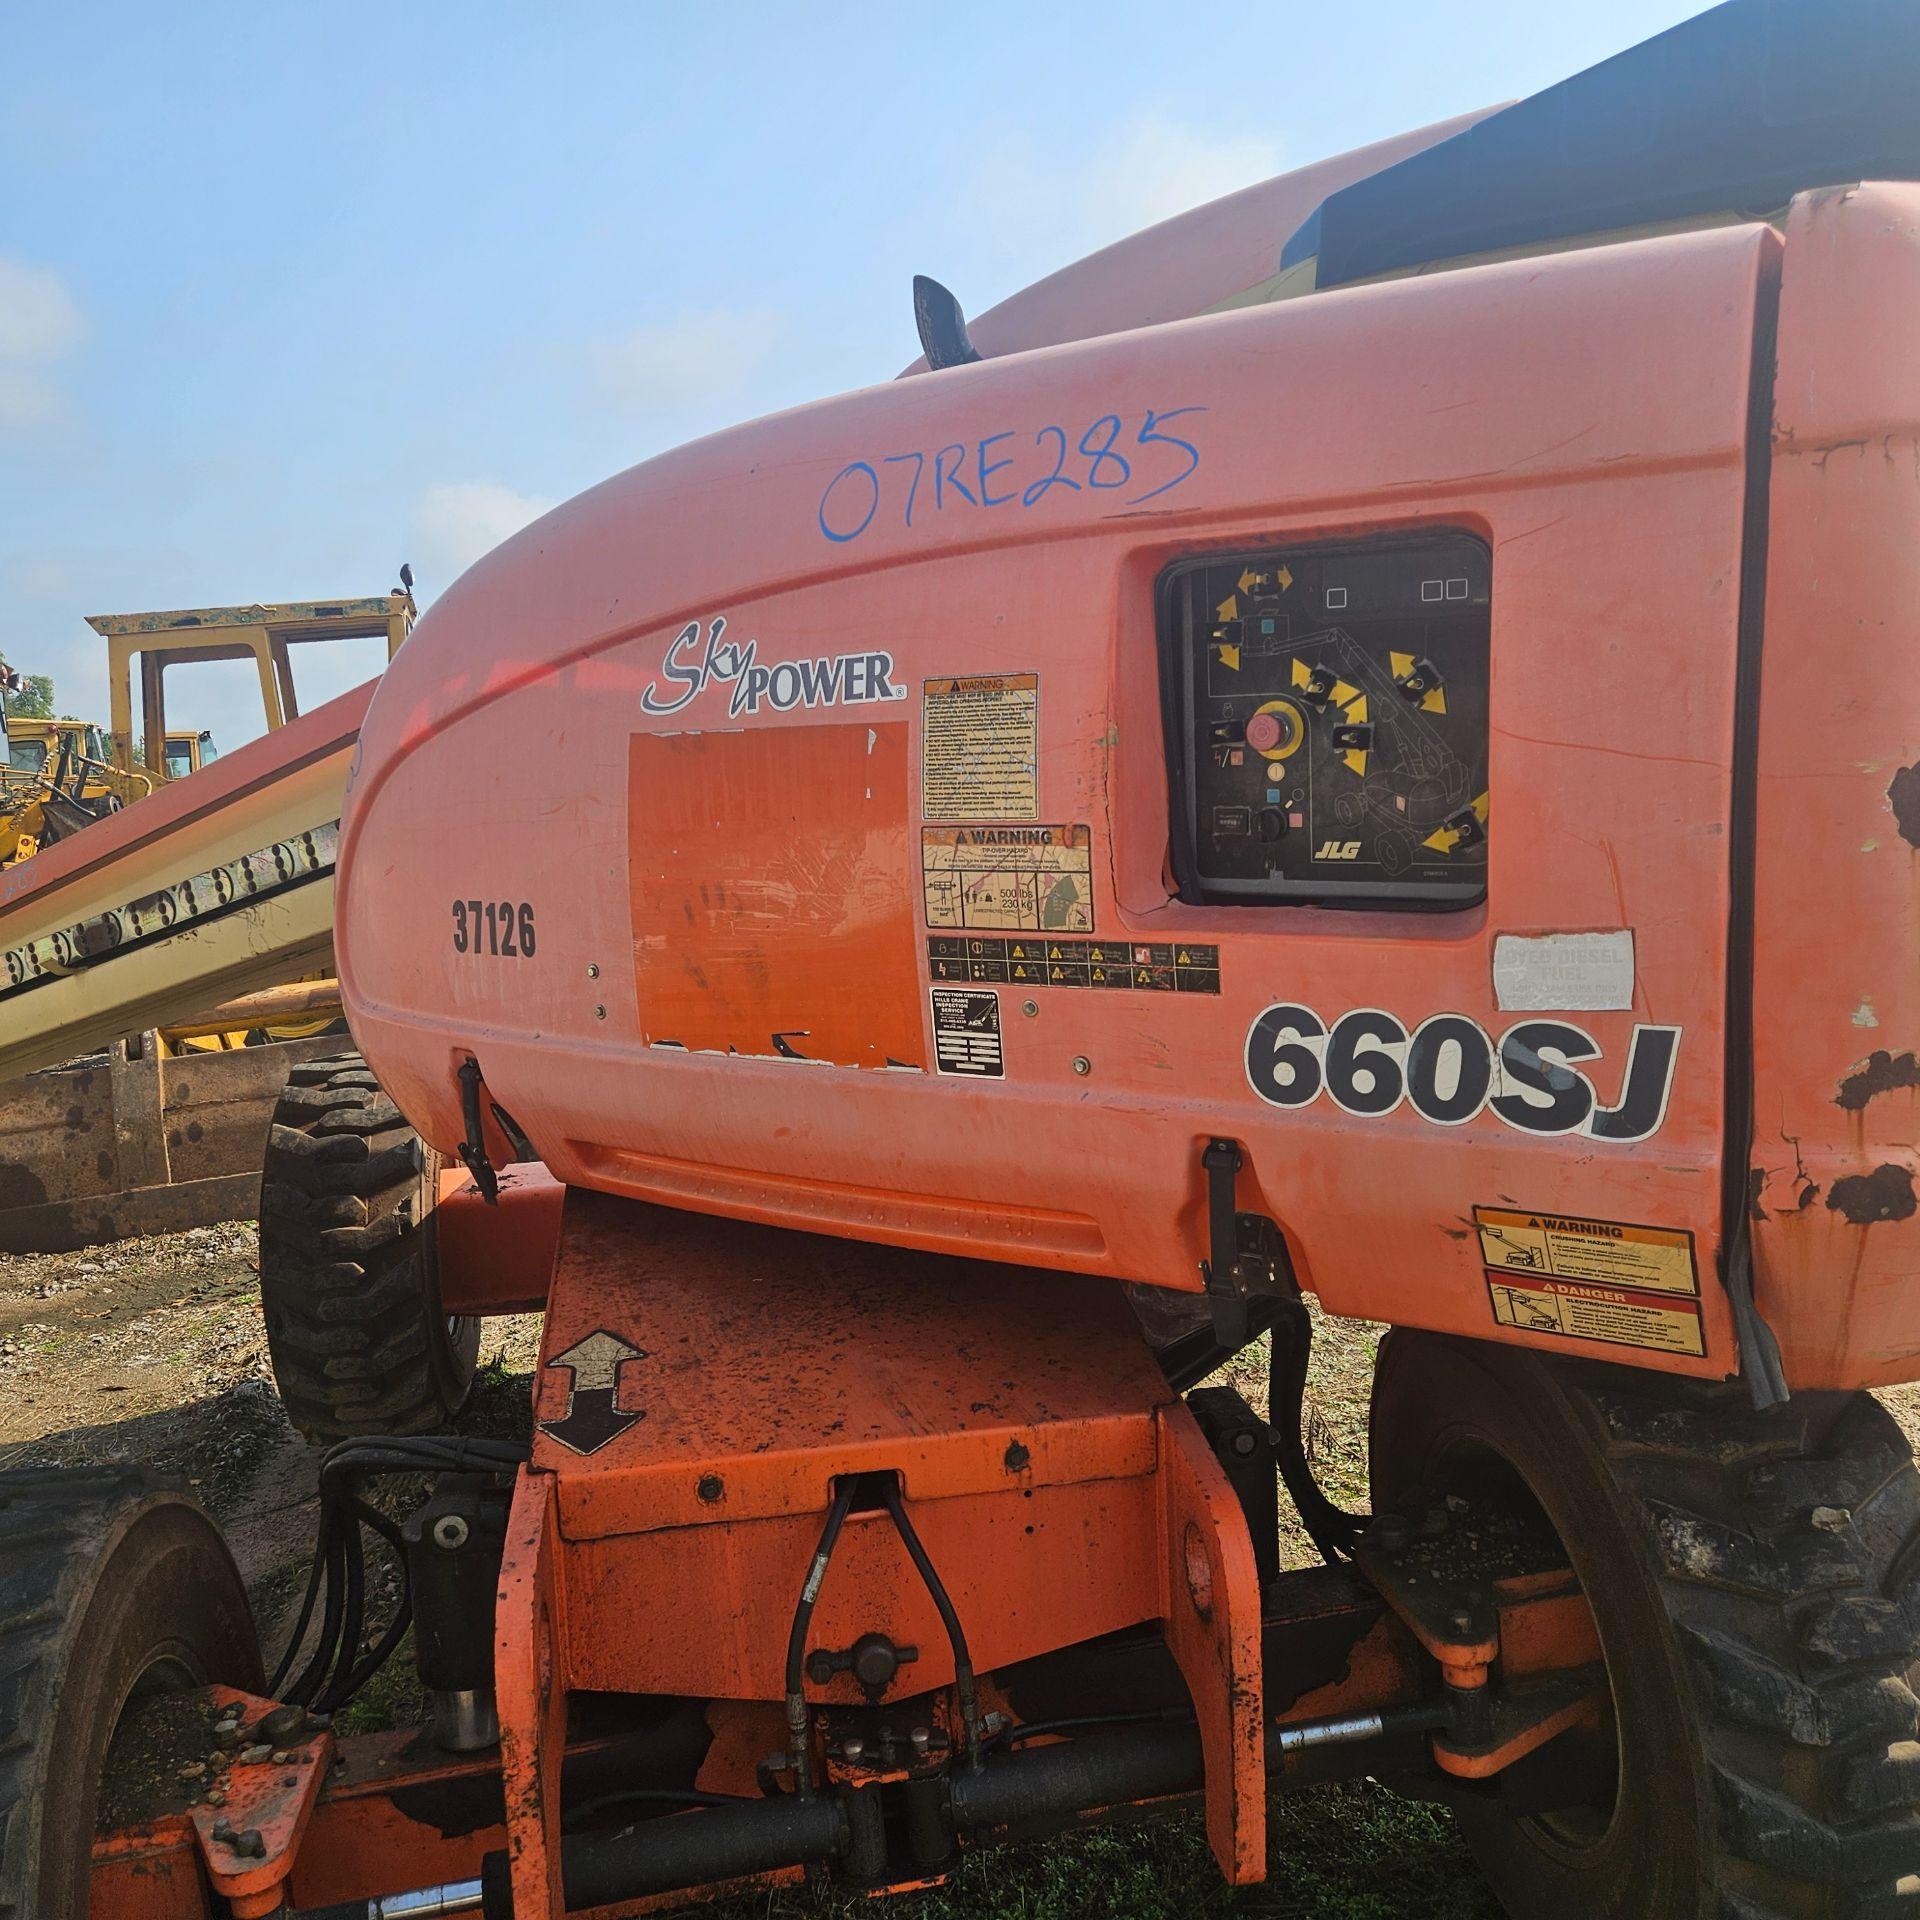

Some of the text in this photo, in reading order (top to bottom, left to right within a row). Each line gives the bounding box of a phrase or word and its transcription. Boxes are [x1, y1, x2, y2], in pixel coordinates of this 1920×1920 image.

[819, 407, 1208, 542] 07RE285
[641, 616, 756, 719] Sky
[961, 679, 1003, 690] WARNING
[972, 830, 1052, 845] WARNING
[1315, 841, 1361, 860] JLG
[1000, 888, 1033, 899] 500 lbs
[1002, 900, 1032, 912] 230 kg
[452, 900, 536, 958] 37126
[1244, 1002, 1682, 1143] 660SJ
[1543, 1218, 1624, 1238] WARNING
[1550, 1234, 1616, 1248] CRUSHING HAZARD
[1558, 1284, 1626, 1302] DANGER
[1566, 1298, 1662, 1316] ELECTROCUTION HAZARD
